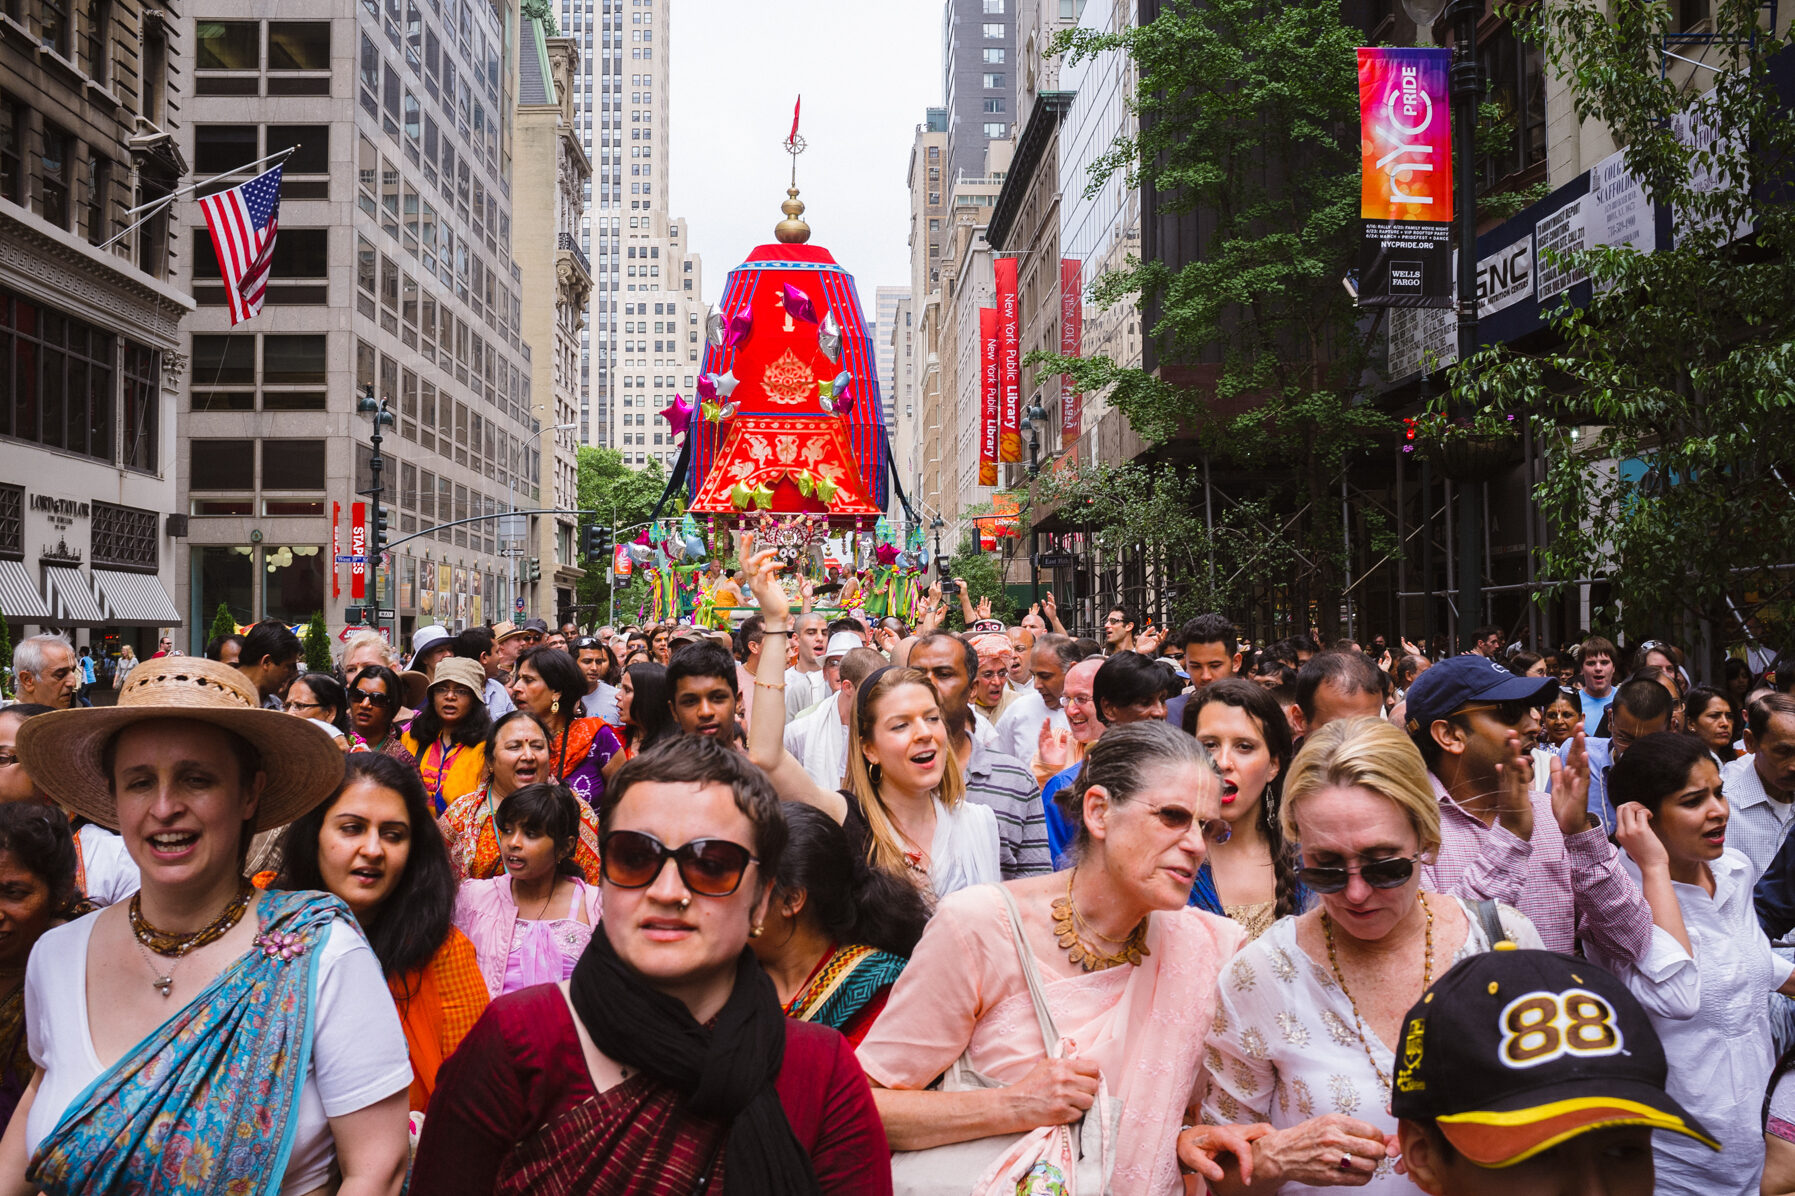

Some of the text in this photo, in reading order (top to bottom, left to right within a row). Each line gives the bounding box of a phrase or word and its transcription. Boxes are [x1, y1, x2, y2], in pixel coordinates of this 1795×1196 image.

[1402, 66, 1418, 116] PRIDE
[1380, 241, 1434, 249] NYCPRIDE.ORG
[1577, 226, 1585, 240] 311
[1392, 270, 1421, 278] WELLS
[1392, 278, 1420, 286] FARGO
[1004, 293, 1018, 429] New York Public Library
[984, 338, 996, 458] New York Public Library
[1498, 988, 1625, 1070] 88
